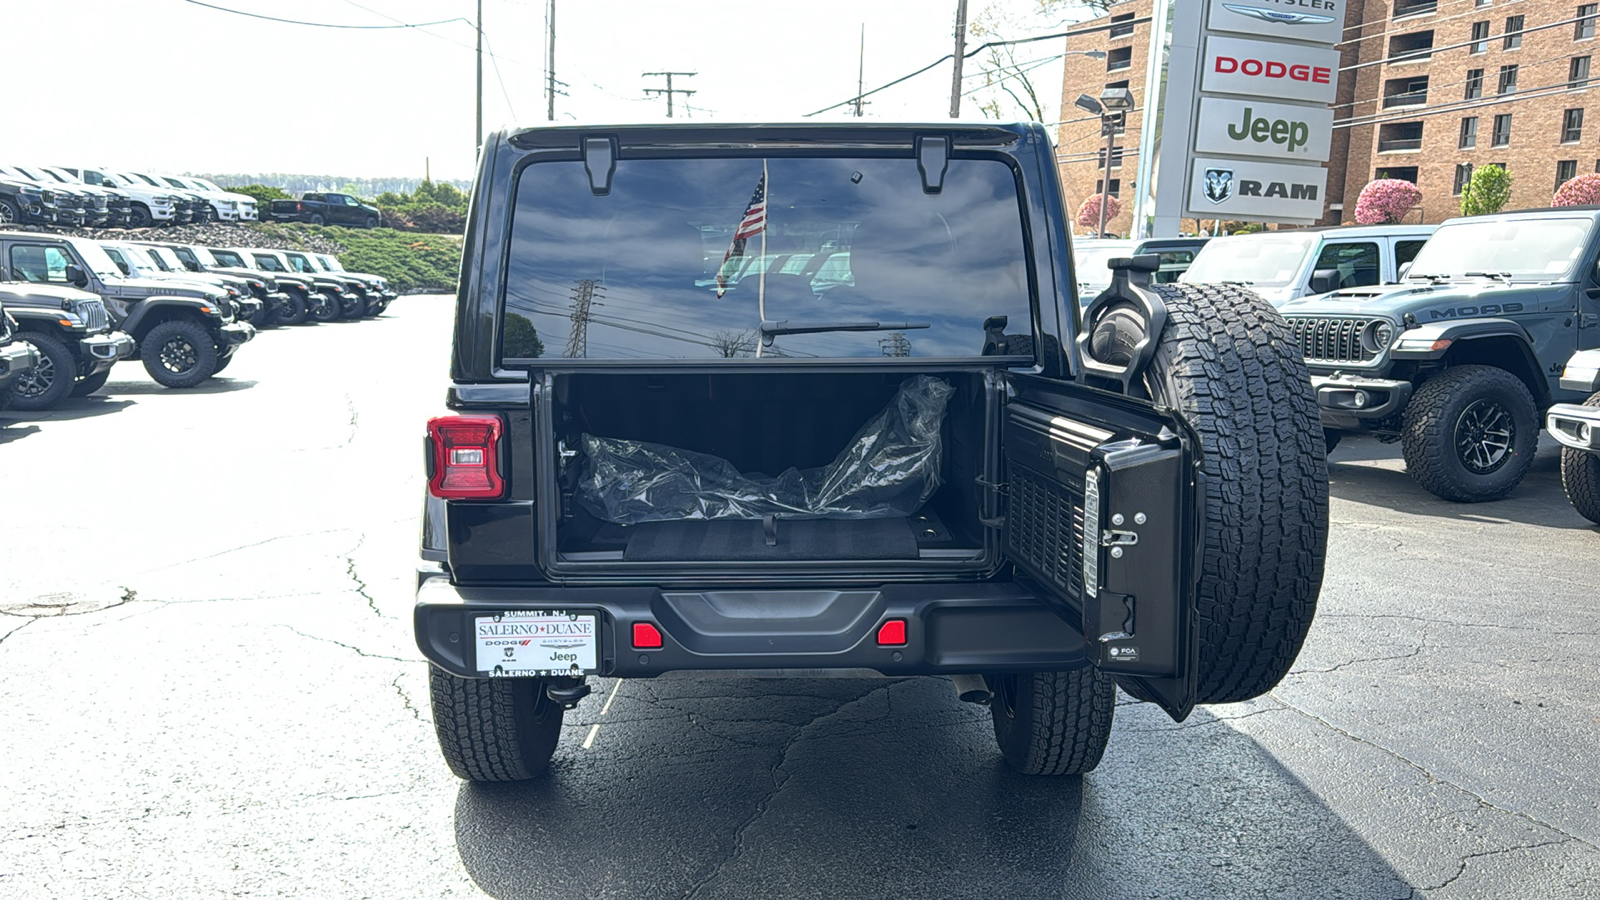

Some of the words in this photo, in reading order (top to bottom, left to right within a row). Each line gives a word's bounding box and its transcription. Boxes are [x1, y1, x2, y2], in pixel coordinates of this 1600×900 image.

[1265, 0, 1335, 11] SLER
[1215, 56, 1331, 84] DODGE
[1228, 107, 1309, 152] Jeep
[1239, 180, 1318, 200] RAM
[1430, 303, 1524, 319] MOAB
[479, 624, 539, 636] SALERNO
[546, 623, 592, 635] DUANE
[550, 652, 577, 662] Jeep
[488, 669, 536, 677] SALERNO
[551, 669, 585, 677] DUANE
